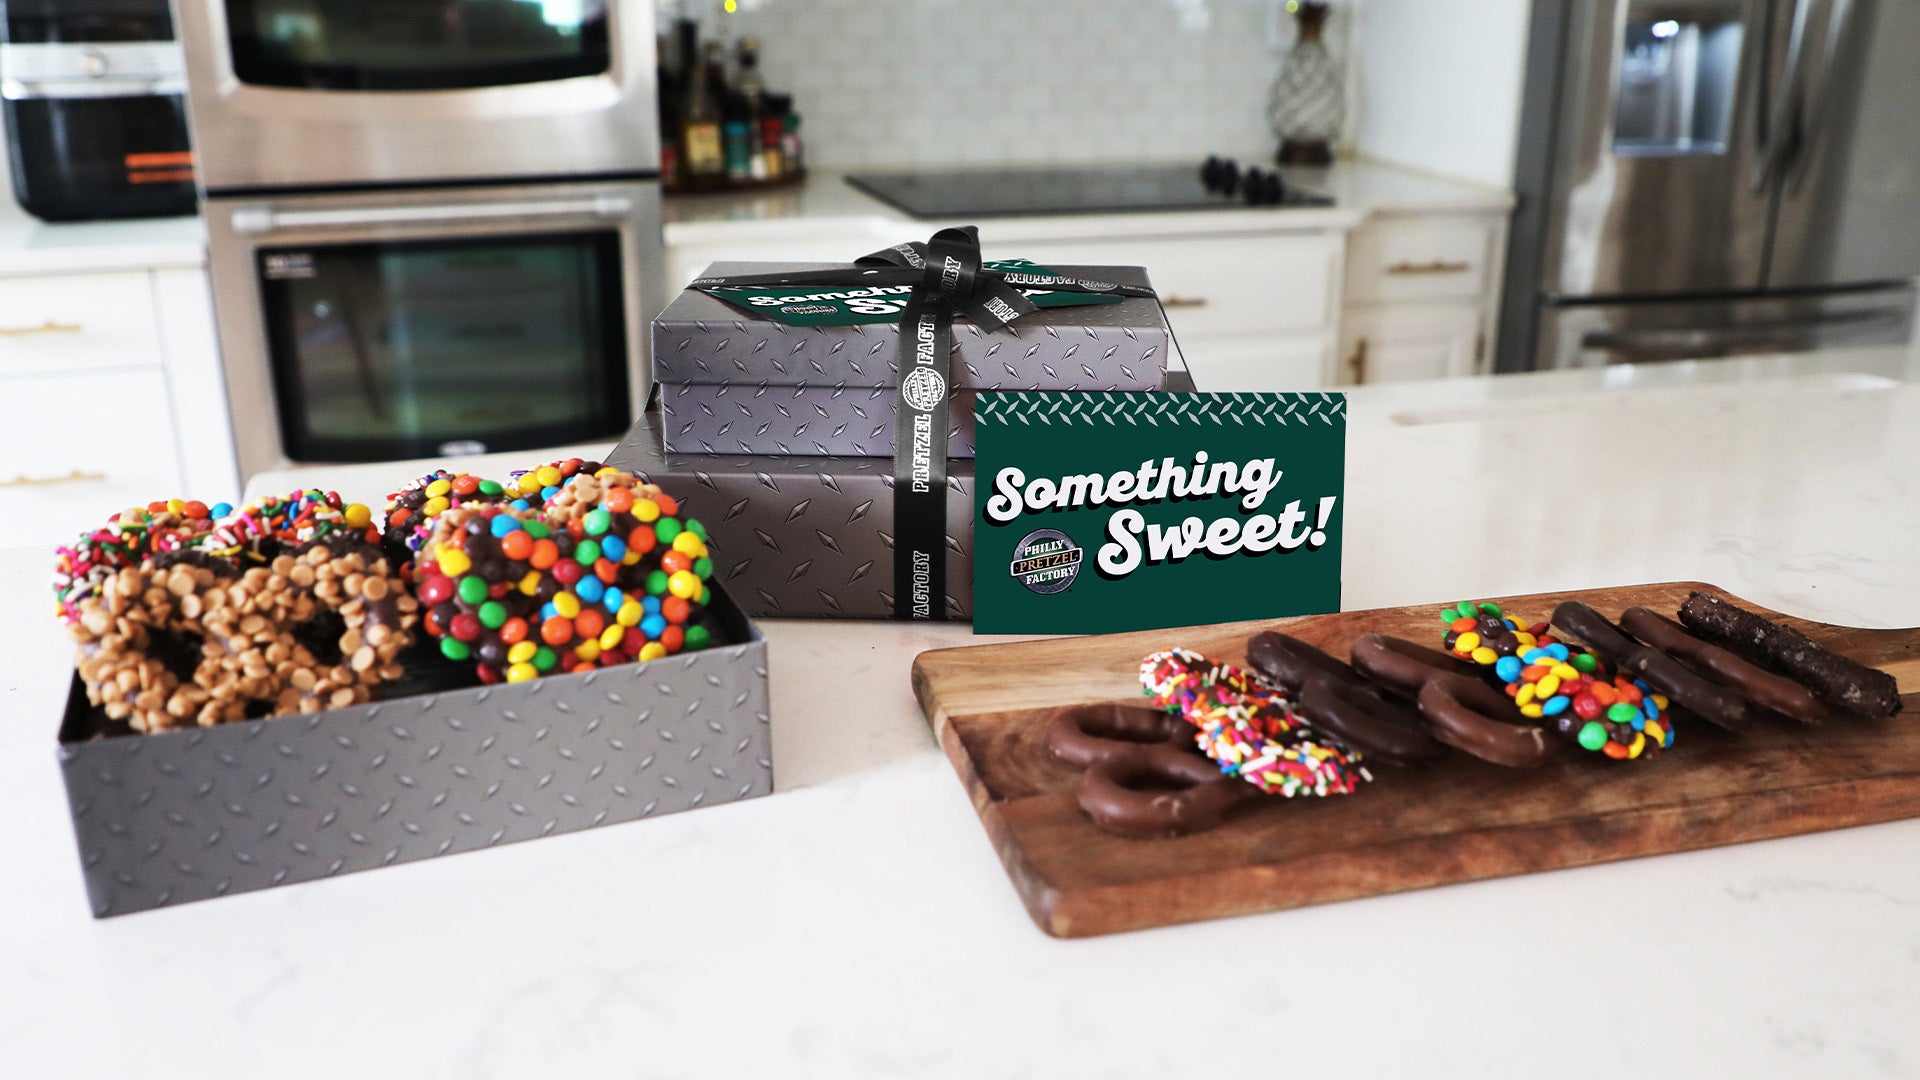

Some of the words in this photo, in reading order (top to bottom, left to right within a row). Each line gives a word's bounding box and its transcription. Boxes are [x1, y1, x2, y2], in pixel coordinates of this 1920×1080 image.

[918, 369, 932, 406] PRETZEL
[912, 413, 932, 492] PRETZEL
[985, 450, 1283, 523] Something
[1024, 539, 1065, 557] PHILLY
[1096, 496, 1337, 577] Sweet!
[1019, 551, 1077, 573] PRETZEL
[1026, 565, 1076, 585] FACTORY
